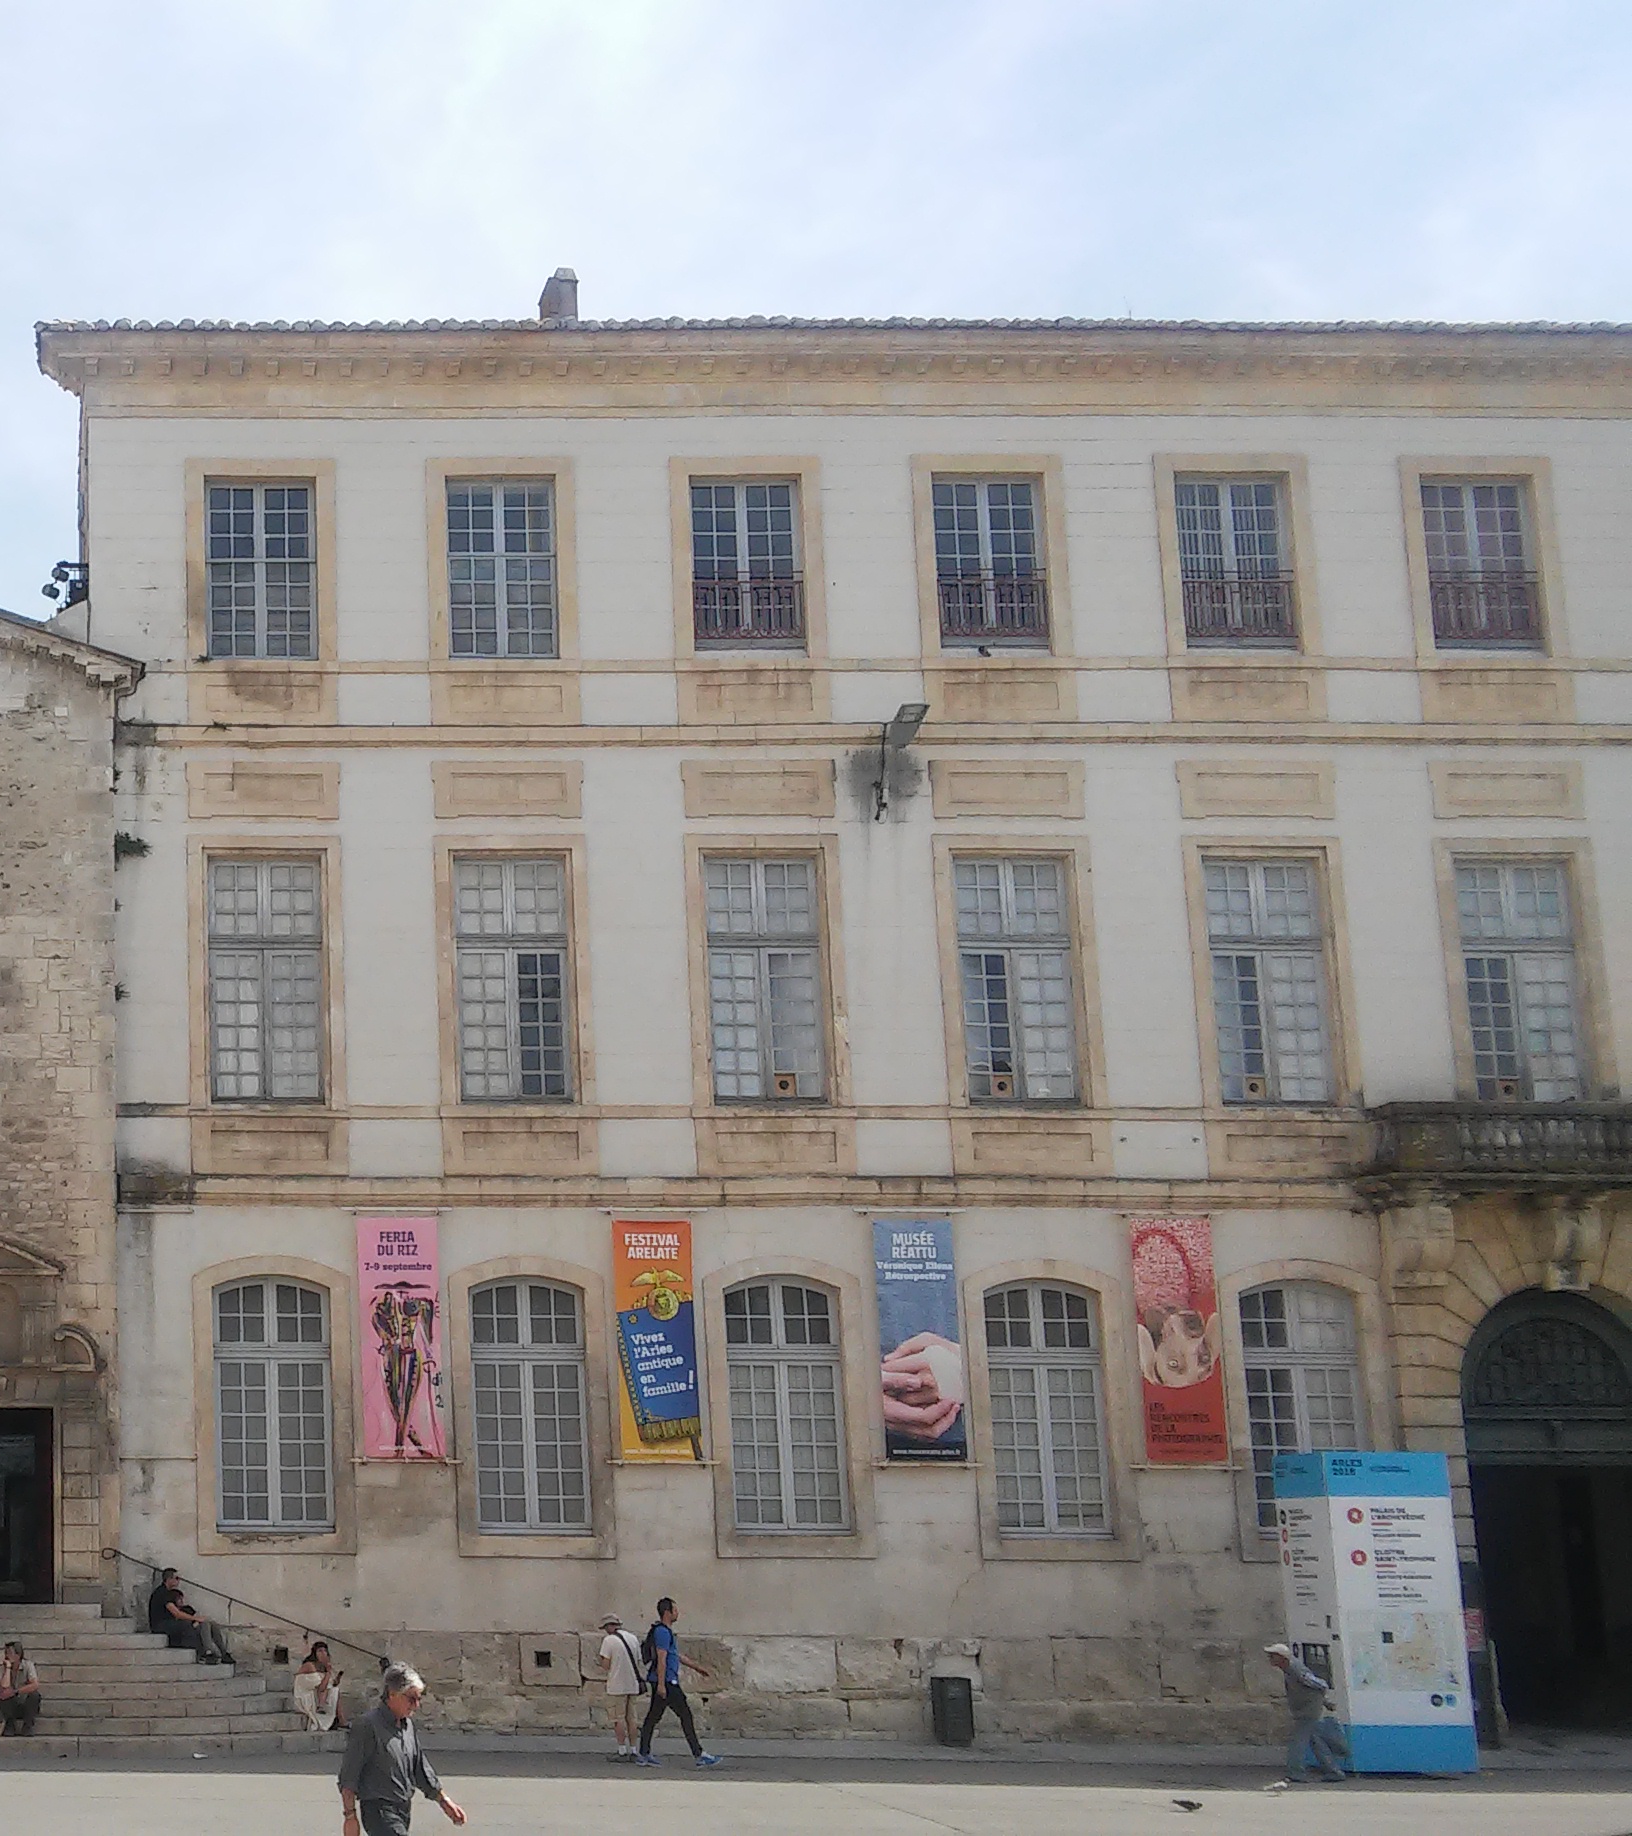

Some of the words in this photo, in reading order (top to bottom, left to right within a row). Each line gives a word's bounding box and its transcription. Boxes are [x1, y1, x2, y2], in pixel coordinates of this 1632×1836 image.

[379, 1231, 415, 1243] FERIA
[624, 1233, 680, 1246] FESTIVAL
[892, 1230, 935, 1245] MUSÉE
[377, 1244, 394, 1256] DU
[397, 1244, 418, 1256] RIZ
[627, 1247, 678, 1259] ARELATE
[891, 1244, 937, 1259] RÉATTU
[364, 1262, 380, 1271] 7-9
[382, 1262, 432, 1272] septembre
[876, 1261, 923, 1271] Véronique
[630, 1332, 665, 1345] Vivez
[633, 1344, 673, 1358] l'Arles
[637, 1356, 684, 1371] antique
[640, 1374, 656, 1384] en
[1331, 1459, 1363, 1467] ARLES
